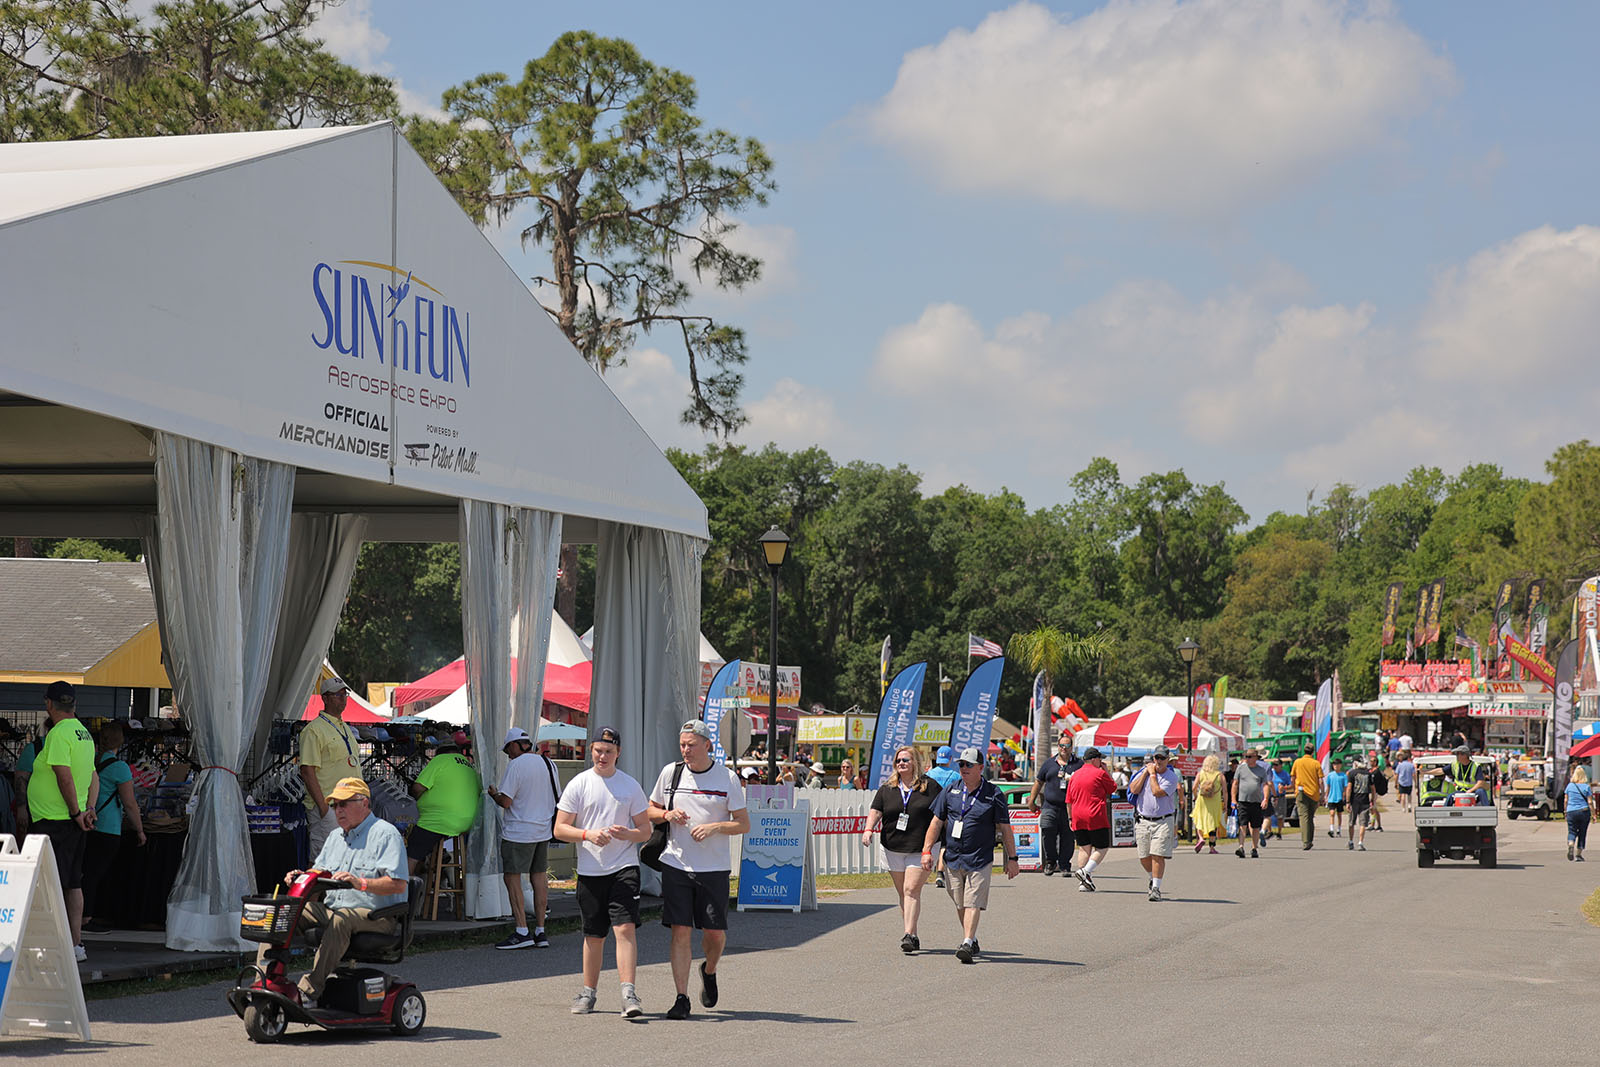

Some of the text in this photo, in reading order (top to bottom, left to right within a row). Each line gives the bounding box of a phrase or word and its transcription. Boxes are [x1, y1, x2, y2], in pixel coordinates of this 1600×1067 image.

[324, 402, 390, 432] OFFICIAL
[279, 421, 390, 460] MERCHANDISE
[426, 424, 460, 438] POWERED BY
[431, 443, 478, 474] Pilot Mall
[1492, 682, 1525, 694] PIZZA
[882, 687, 902, 750] Orange Juice
[893, 689, 915, 751] SAMPLES
[1471, 702, 1512, 716] PIZZA
[1554, 681, 1574, 762] FLYING
[760, 817, 791, 826] OFFICIAL
[764, 828, 787, 836] EVENT
[748, 838, 799, 847] MERCHANDISE
